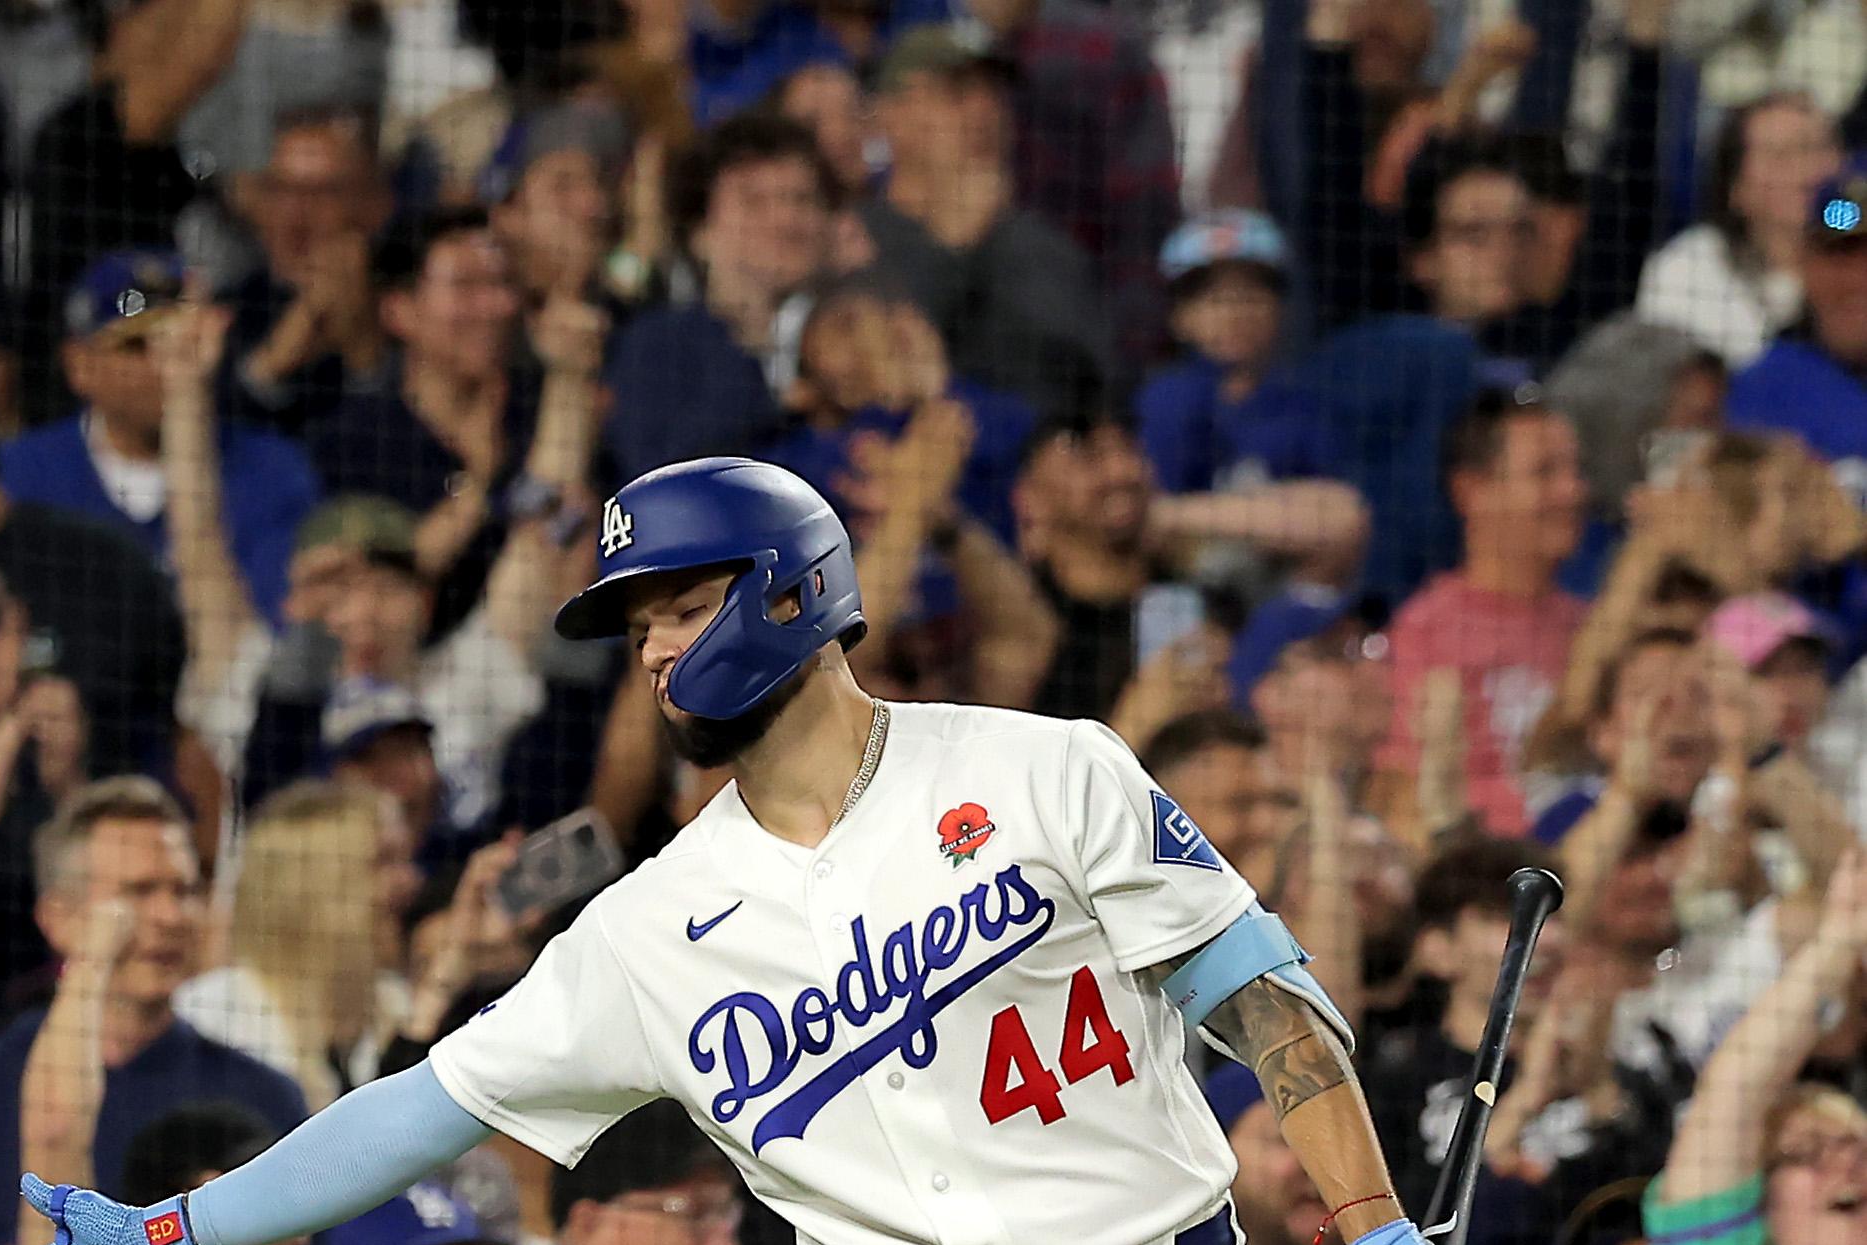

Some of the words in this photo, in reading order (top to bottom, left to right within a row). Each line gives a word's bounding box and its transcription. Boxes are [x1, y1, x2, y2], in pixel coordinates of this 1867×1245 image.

[600, 496, 633, 558] LA
[1163, 807, 1195, 845] G
[688, 863, 1048, 1123] Dodgers
[979, 964, 1136, 1127] 44
